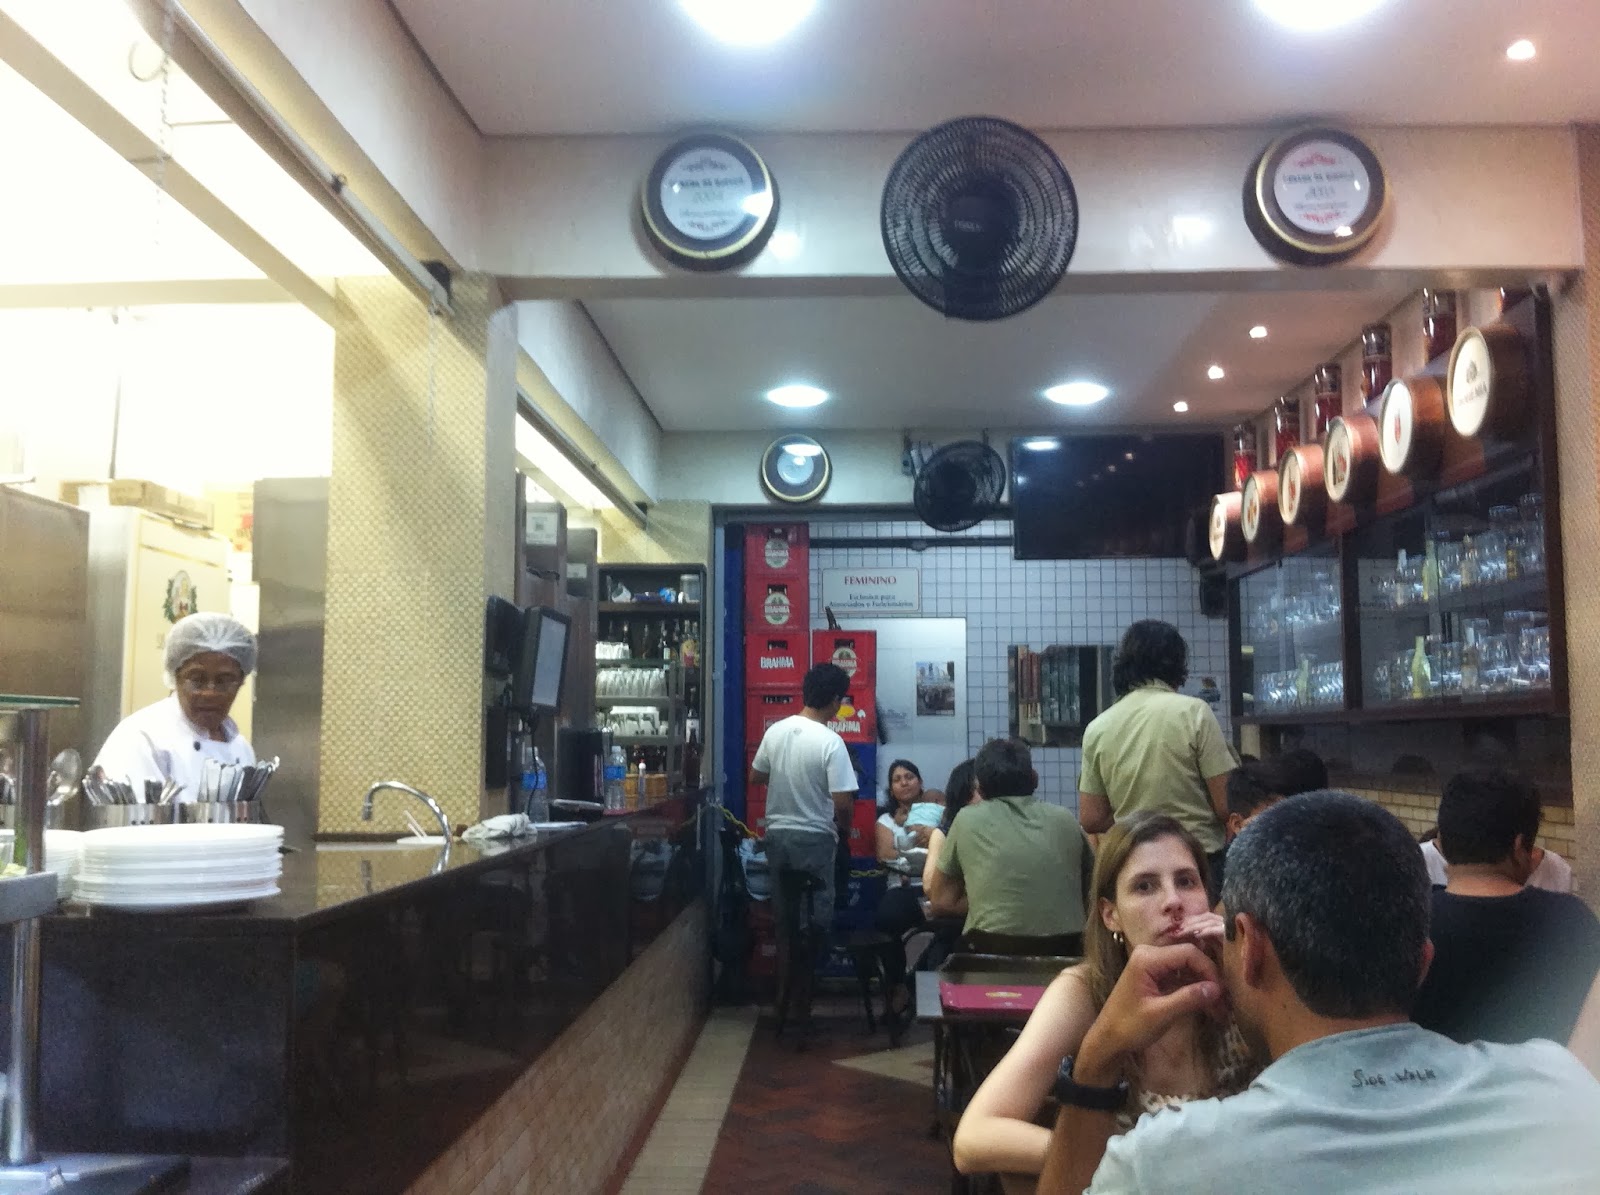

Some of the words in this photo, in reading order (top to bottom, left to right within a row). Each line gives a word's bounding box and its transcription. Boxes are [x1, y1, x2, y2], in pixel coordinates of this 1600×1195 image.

[844, 575, 897, 585] FEMININO
[764, 605, 790, 614] BRAHMA
[760, 656, 794, 669] BRAHMA
[826, 720, 861, 733] BRAHMA
